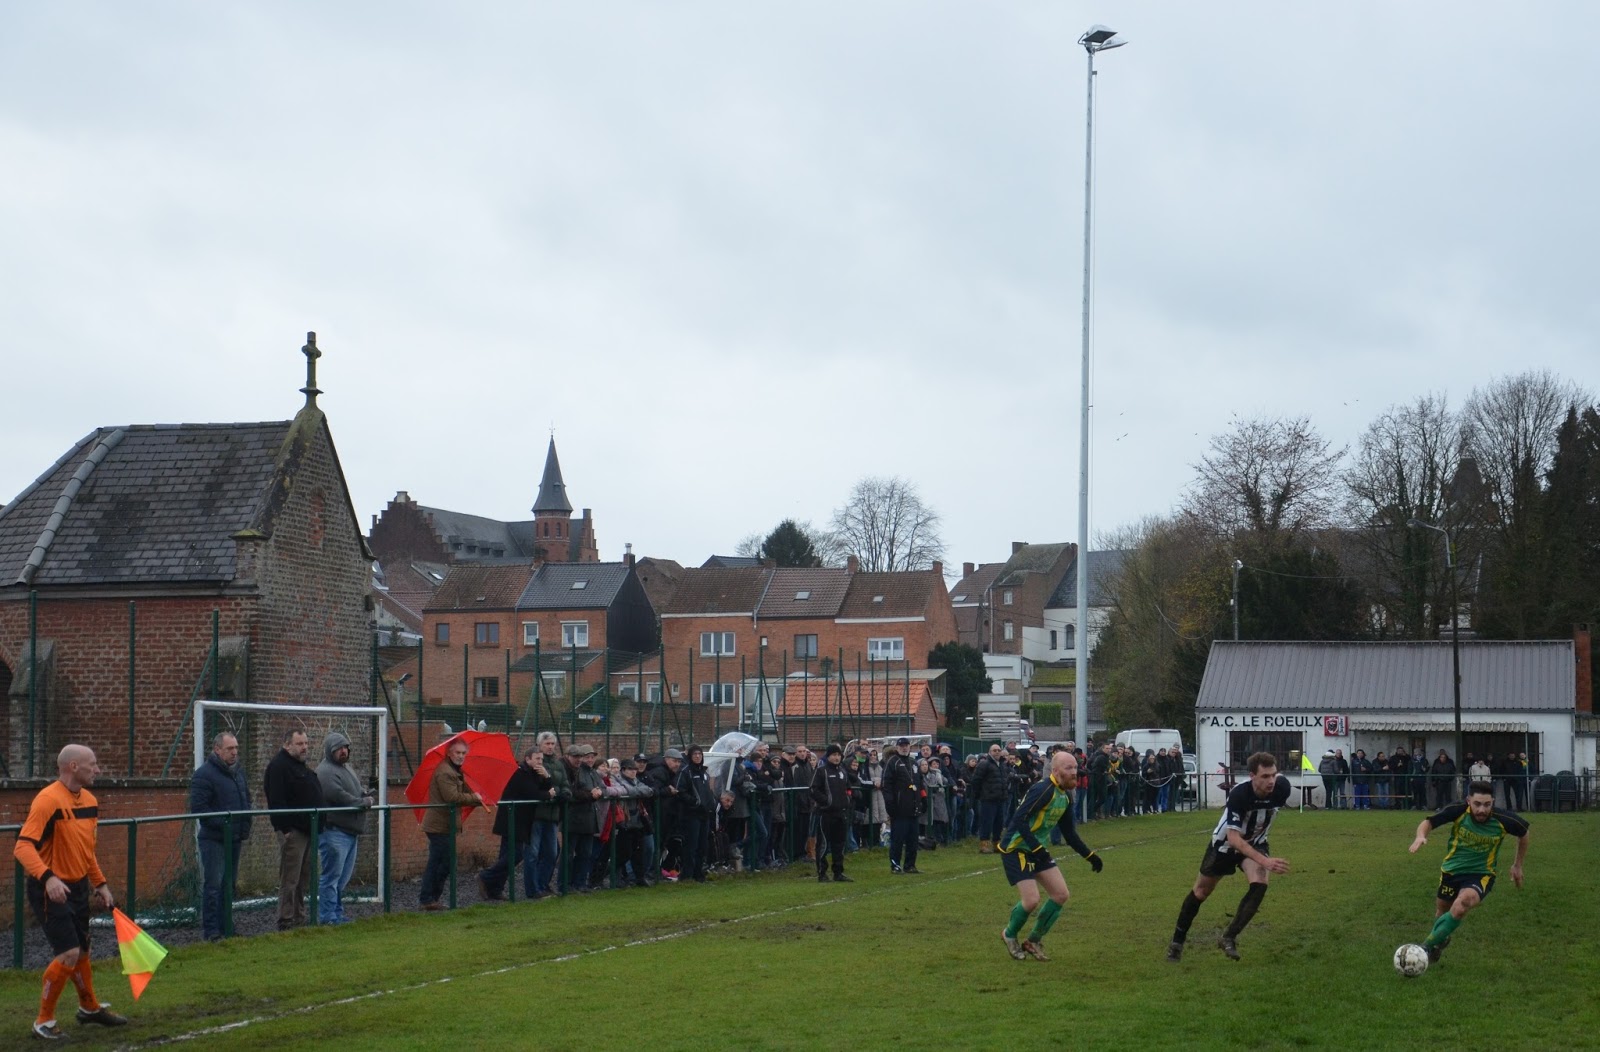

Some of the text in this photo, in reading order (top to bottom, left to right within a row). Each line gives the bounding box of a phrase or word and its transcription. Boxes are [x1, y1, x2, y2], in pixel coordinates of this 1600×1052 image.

[1210, 716, 1323, 727] A.C. LE ROEULX
